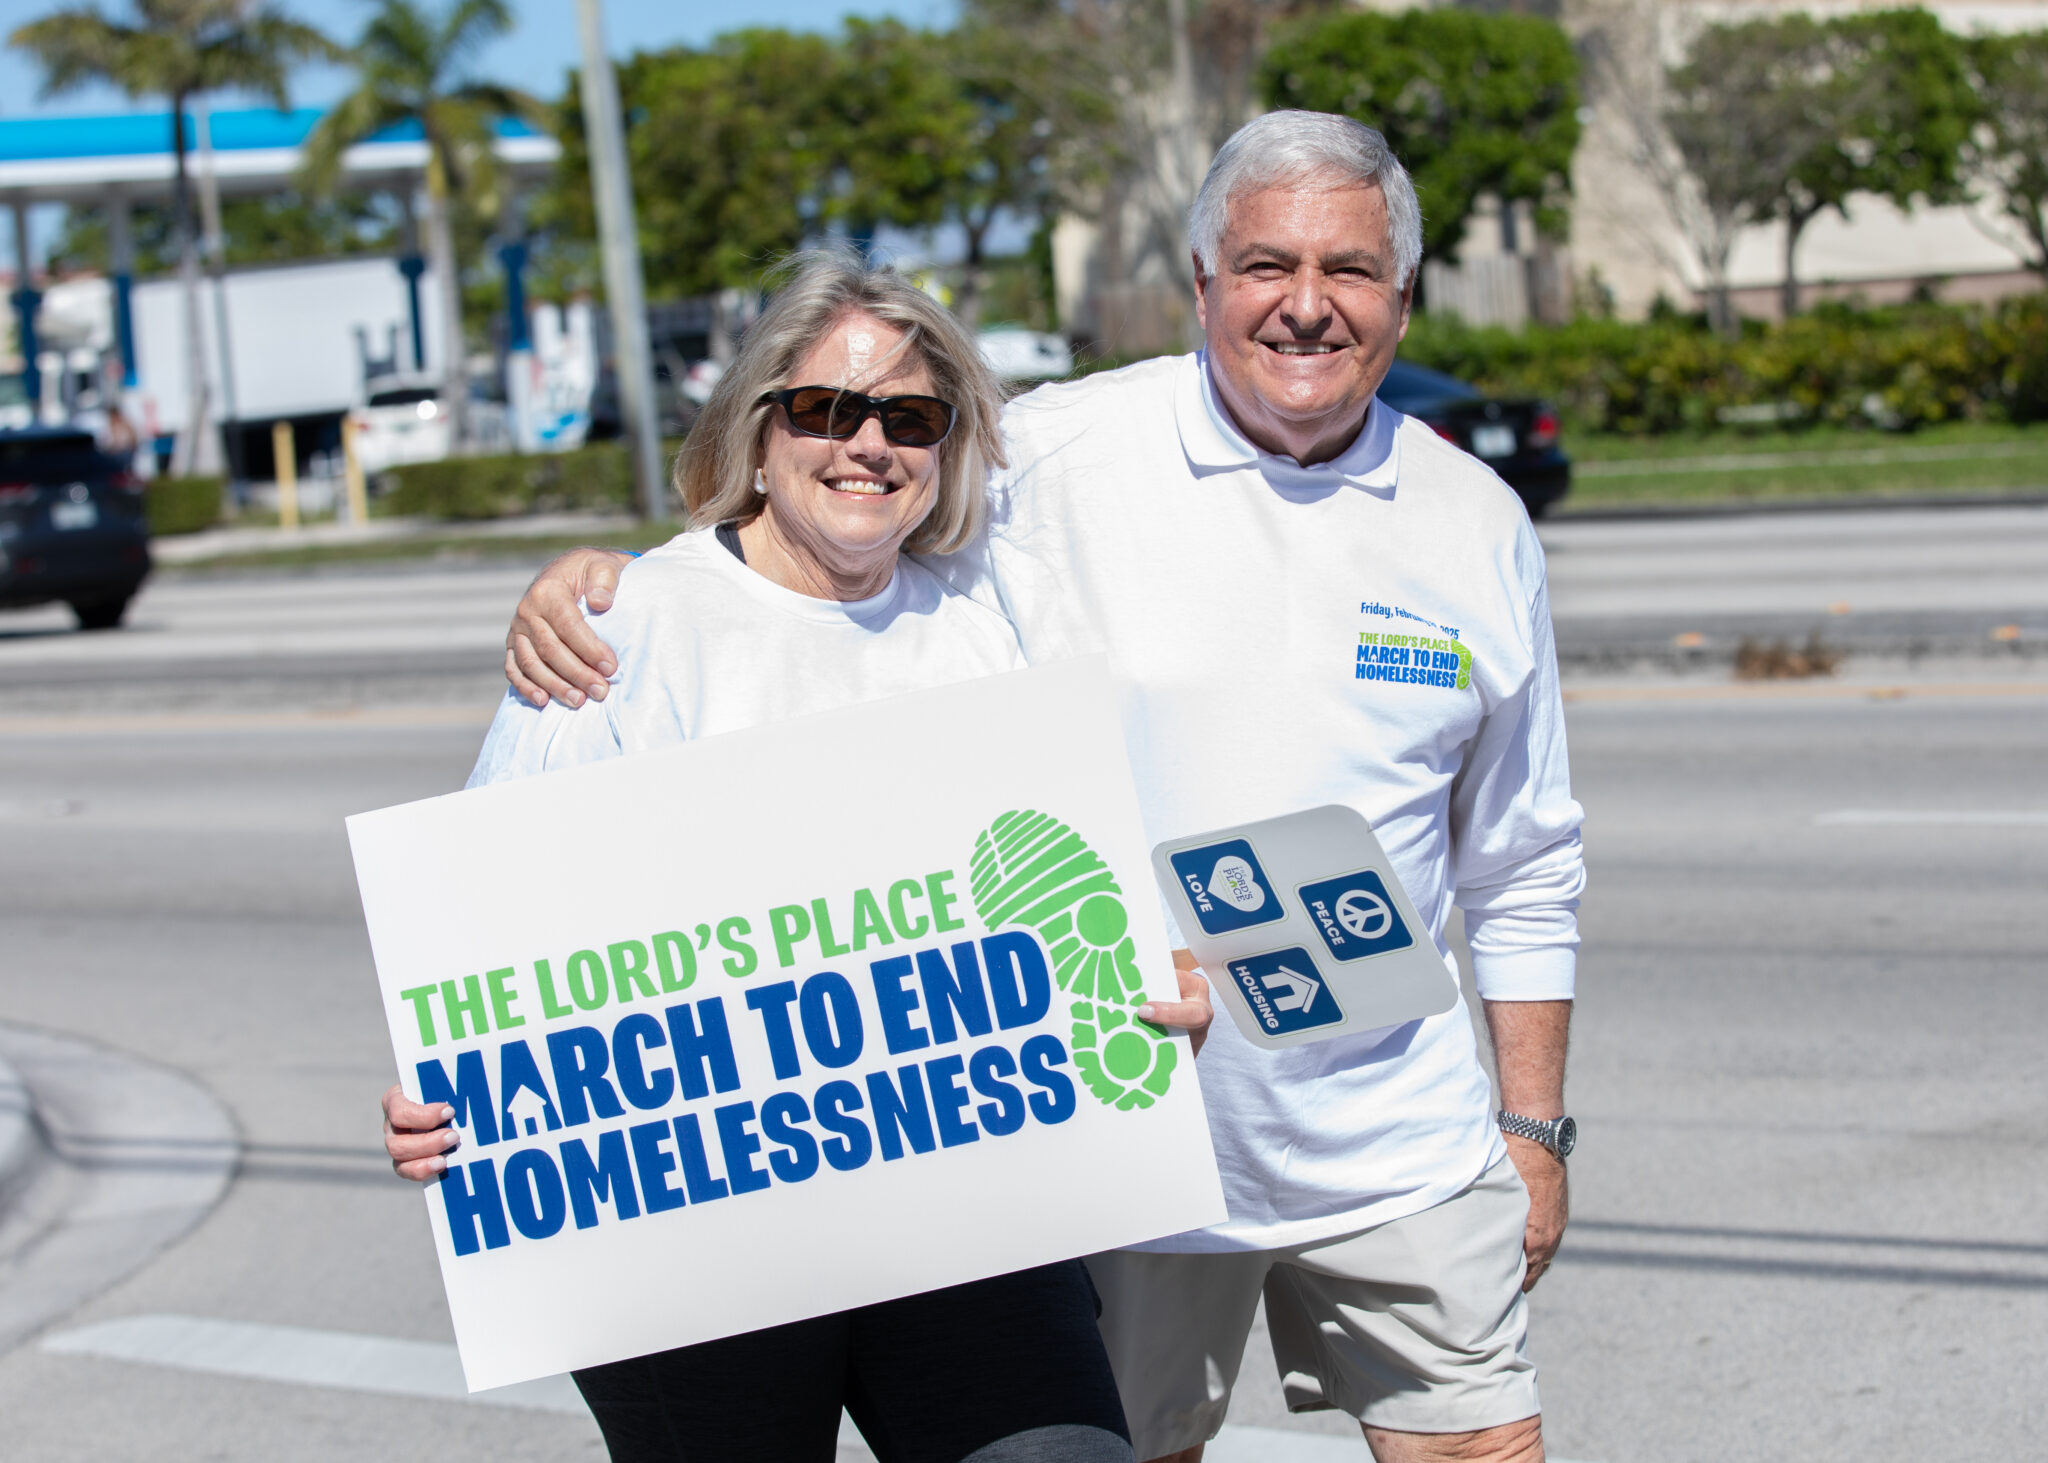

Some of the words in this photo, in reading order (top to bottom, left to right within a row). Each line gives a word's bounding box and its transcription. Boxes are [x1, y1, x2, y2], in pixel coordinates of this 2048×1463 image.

[1360, 602, 1393, 619] Friday,
[1356, 645, 1409, 666] MARCH
[1413, 649, 1430, 668] TO
[1432, 651, 1459, 671] END
[1359, 632, 1379, 645] THE
[1381, 633, 1418, 648] LORD'S
[1420, 637, 1449, 651] PLACE
[1355, 663, 1457, 688] HOMELESSNESS
[1185, 873, 1213, 913] LOVE
[1312, 901, 1345, 947] PEACE
[401, 968, 525, 1046] THE
[535, 917, 757, 1018] LORD'S
[770, 871, 965, 966] PLACE
[1235, 965, 1279, 1030] HOUSING
[416, 997, 740, 1146] MARCH
[745, 972, 863, 1080] TO
[870, 932, 1050, 1055] END
[440, 1035, 1075, 1256] HOMELESSNESS
